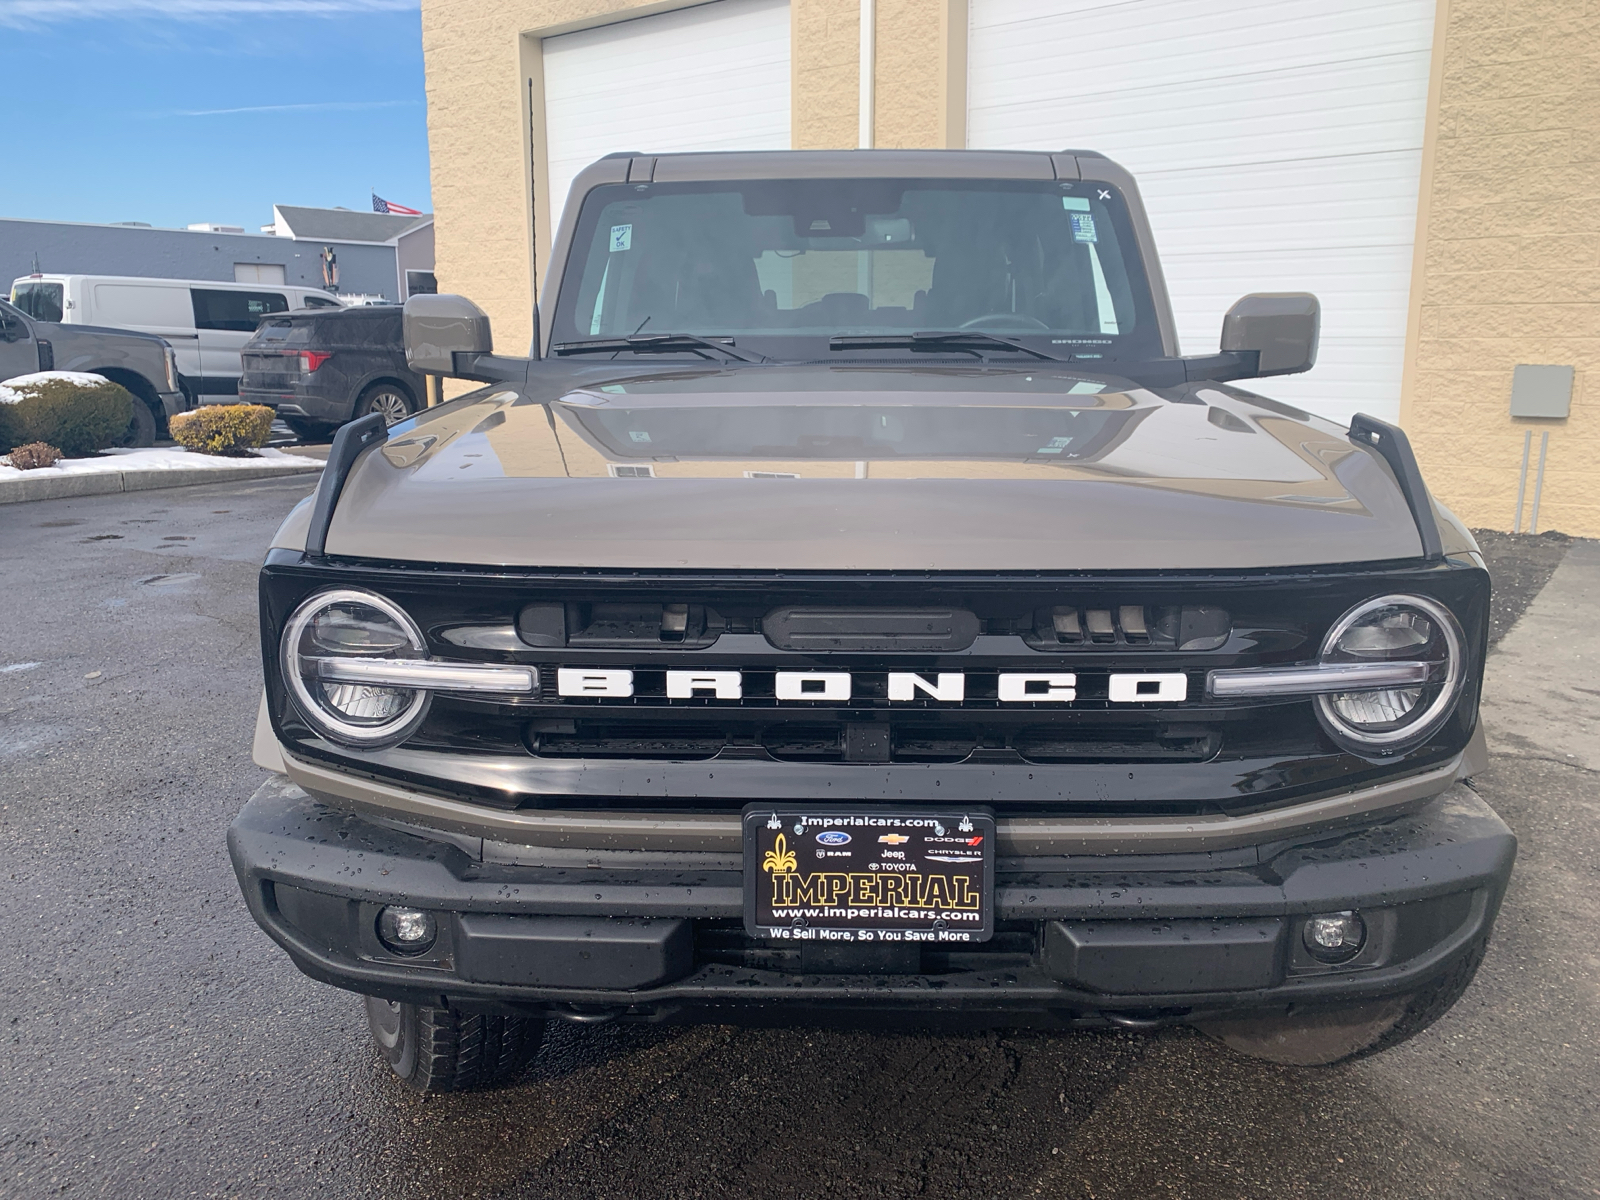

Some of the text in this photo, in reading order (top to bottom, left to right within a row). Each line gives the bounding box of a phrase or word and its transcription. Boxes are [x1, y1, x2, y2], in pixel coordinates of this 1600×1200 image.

[557, 667, 1189, 704] BRONCO
[801, 816, 939, 828] Imperialcars.com
[881, 849, 905, 860] Jeep
[881, 863, 917, 871] TOYOTA
[772, 872, 979, 909] IMPERIAL
[772, 907, 980, 921] www.imperialcars.com
[769, 928, 970, 942] We Sell More, So You Save More
